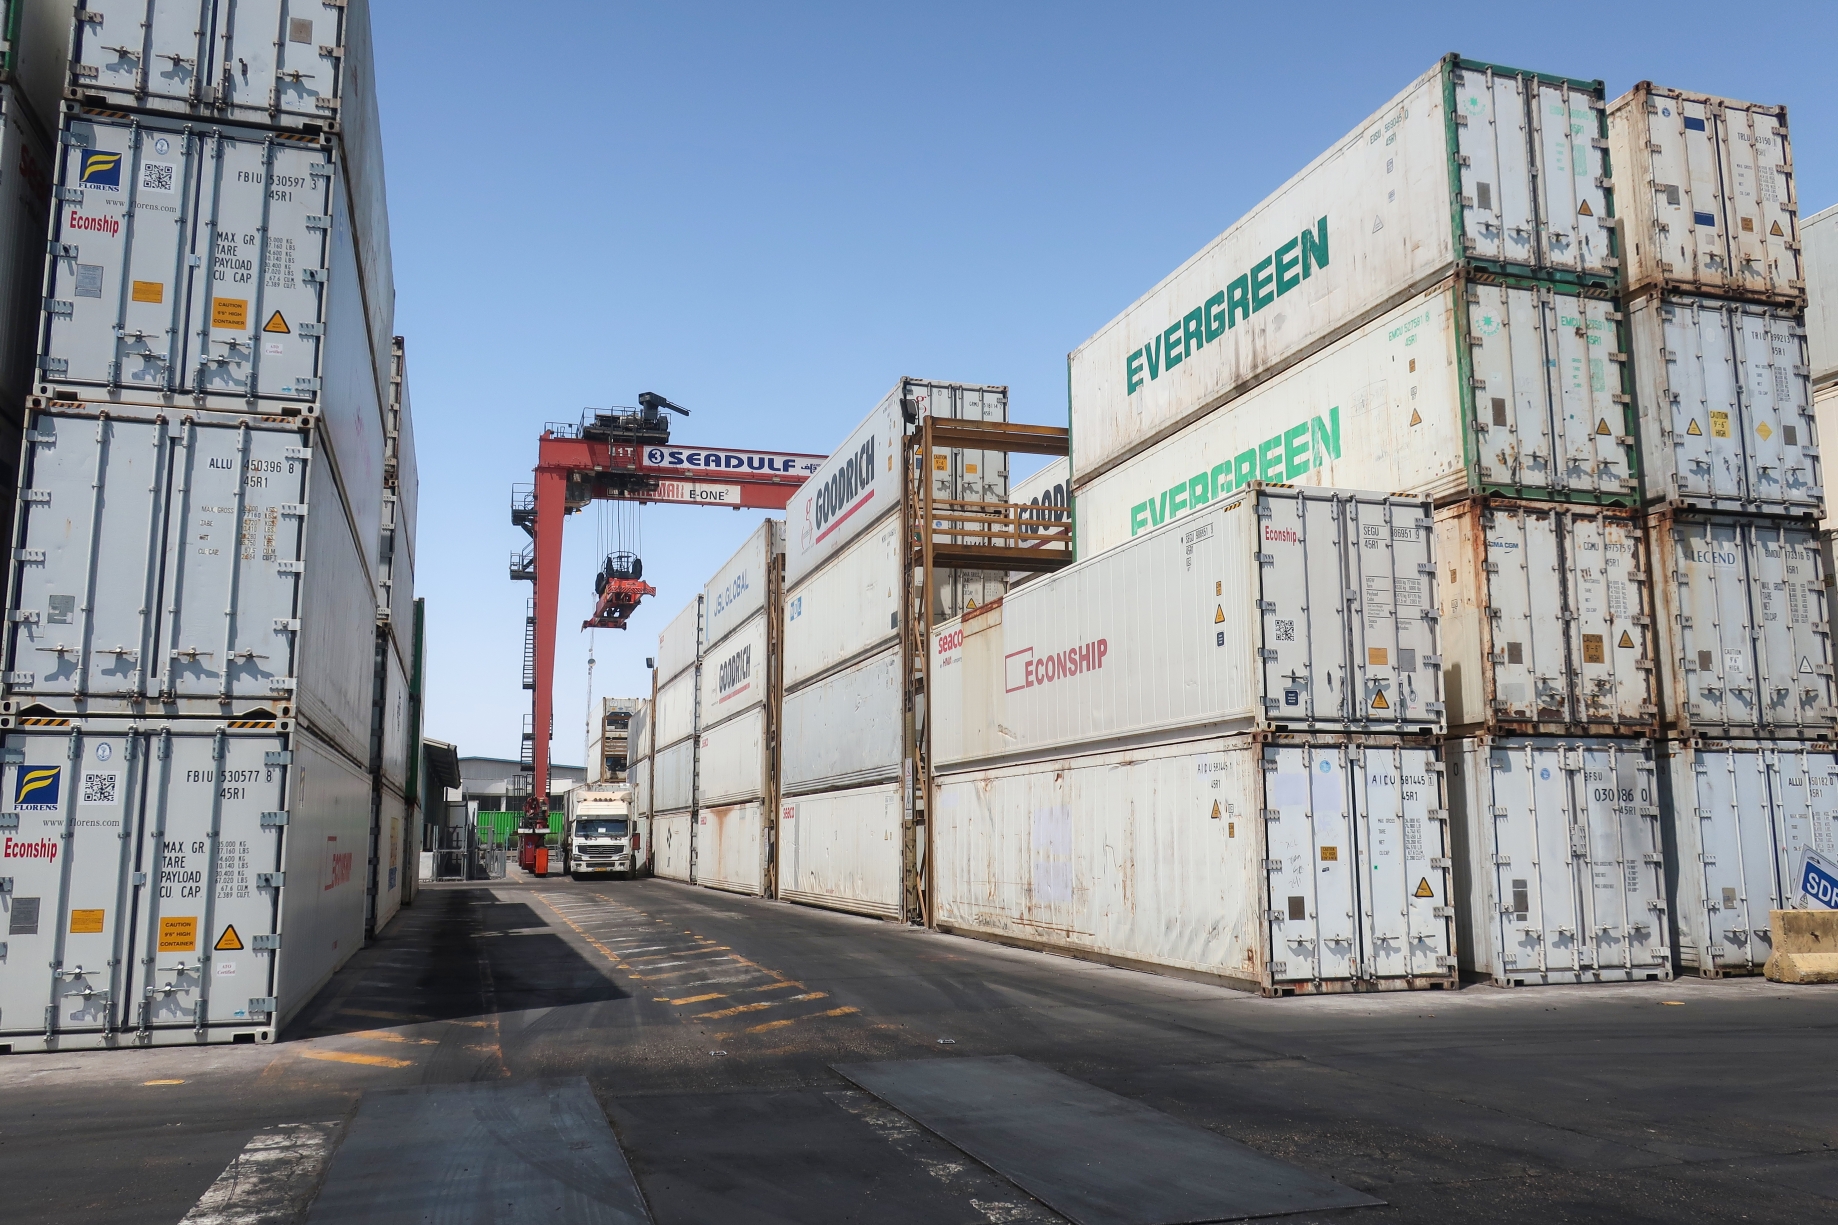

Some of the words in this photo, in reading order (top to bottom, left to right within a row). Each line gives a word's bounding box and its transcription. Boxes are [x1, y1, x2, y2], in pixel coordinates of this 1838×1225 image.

[1755, 136, 1772, 146] 63150
[79, 182, 120, 192] FLORENS
[238, 171, 262, 184] FBIU
[269, 175, 305, 188] 530597
[311, 178, 318, 190] 3
[269, 190, 292, 202] 45R1
[70, 211, 119, 238] Econship
[216, 244, 238, 257] TARE
[215, 257, 252, 271] PAYLOAD
[1127, 215, 1329, 396] EVERGREEN
[1561, 316, 1581, 328] EMCU
[1710, 411, 1728, 419] CAUTION
[209, 458, 233, 470] ALLU
[244, 460, 282, 473] 450396
[288, 463, 294, 474] 8
[669, 452, 796, 472] SEADULF
[1131, 405, 1341, 536] EVERGREEN
[244, 476, 268, 488] 45R1
[816, 434, 874, 530] GOODRICH
[1019, 478, 1071, 542] GOOD
[1265, 526, 1297, 546] Econship
[1364, 526, 1380, 537] SEGU
[1416, 529, 1420, 540] 9
[1365, 540, 1379, 550] 45R1
[1584, 542, 1599, 551] CGMU
[1807, 552, 1811, 560] 6
[726, 569, 749, 607] GLOBAL
[938, 629, 964, 655] seaco
[1583, 635, 1603, 644] CAUTION
[719, 644, 751, 693] GOODRICH
[1025, 639, 1108, 688] ECONSHIP
[187, 771, 213, 782] FBIU
[220, 771, 260, 783] 530577
[266, 770, 273, 782] 8
[1401, 775, 1426, 785] 581445
[1788, 778, 1803, 787] ALLU
[220, 788, 245, 800] 45R1
[1402, 792, 1418, 801] 45R1
[1642, 789, 1648, 802] 0
[1620, 806, 1636, 816] 45R1
[70, 818, 120, 827] florens.com
[4, 837, 58, 863] Econship
[162, 842, 185, 854] MAX.
[192, 842, 206, 854] GR.
[162, 856, 186, 869] TARE
[161, 871, 202, 883] PAYLOAD
[181, 886, 202, 898] CAP.
